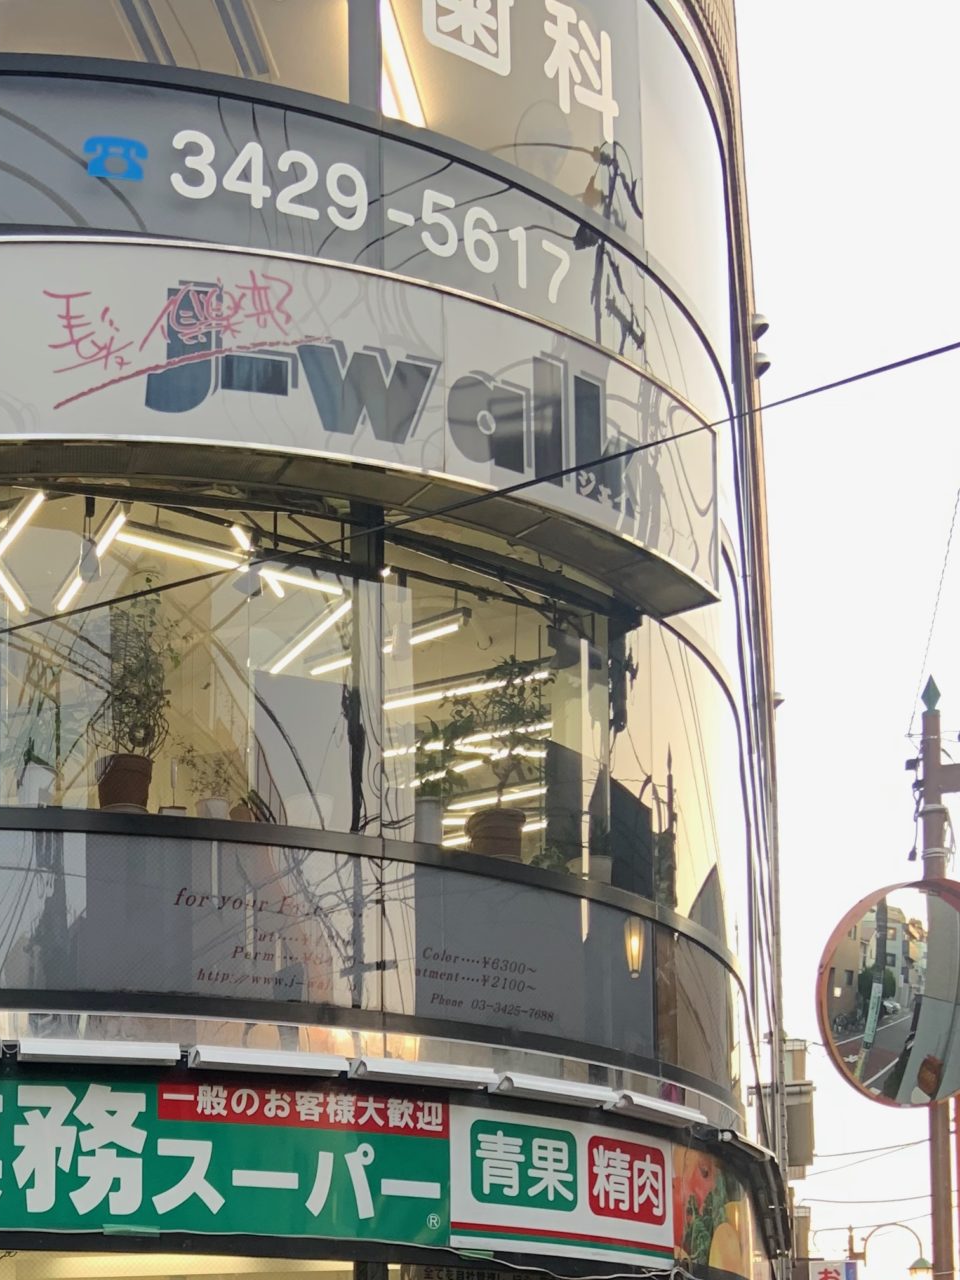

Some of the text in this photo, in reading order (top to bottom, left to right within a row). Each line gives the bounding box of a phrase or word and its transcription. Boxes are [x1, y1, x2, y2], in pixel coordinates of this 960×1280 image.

[169, 129, 572, 304] 3429-5617
[162, 1083, 445, 1133] 一般のお客様大歓迎
[475, 1130, 575, 1202] 青果
[592, 1143, 666, 1218] 精肉
